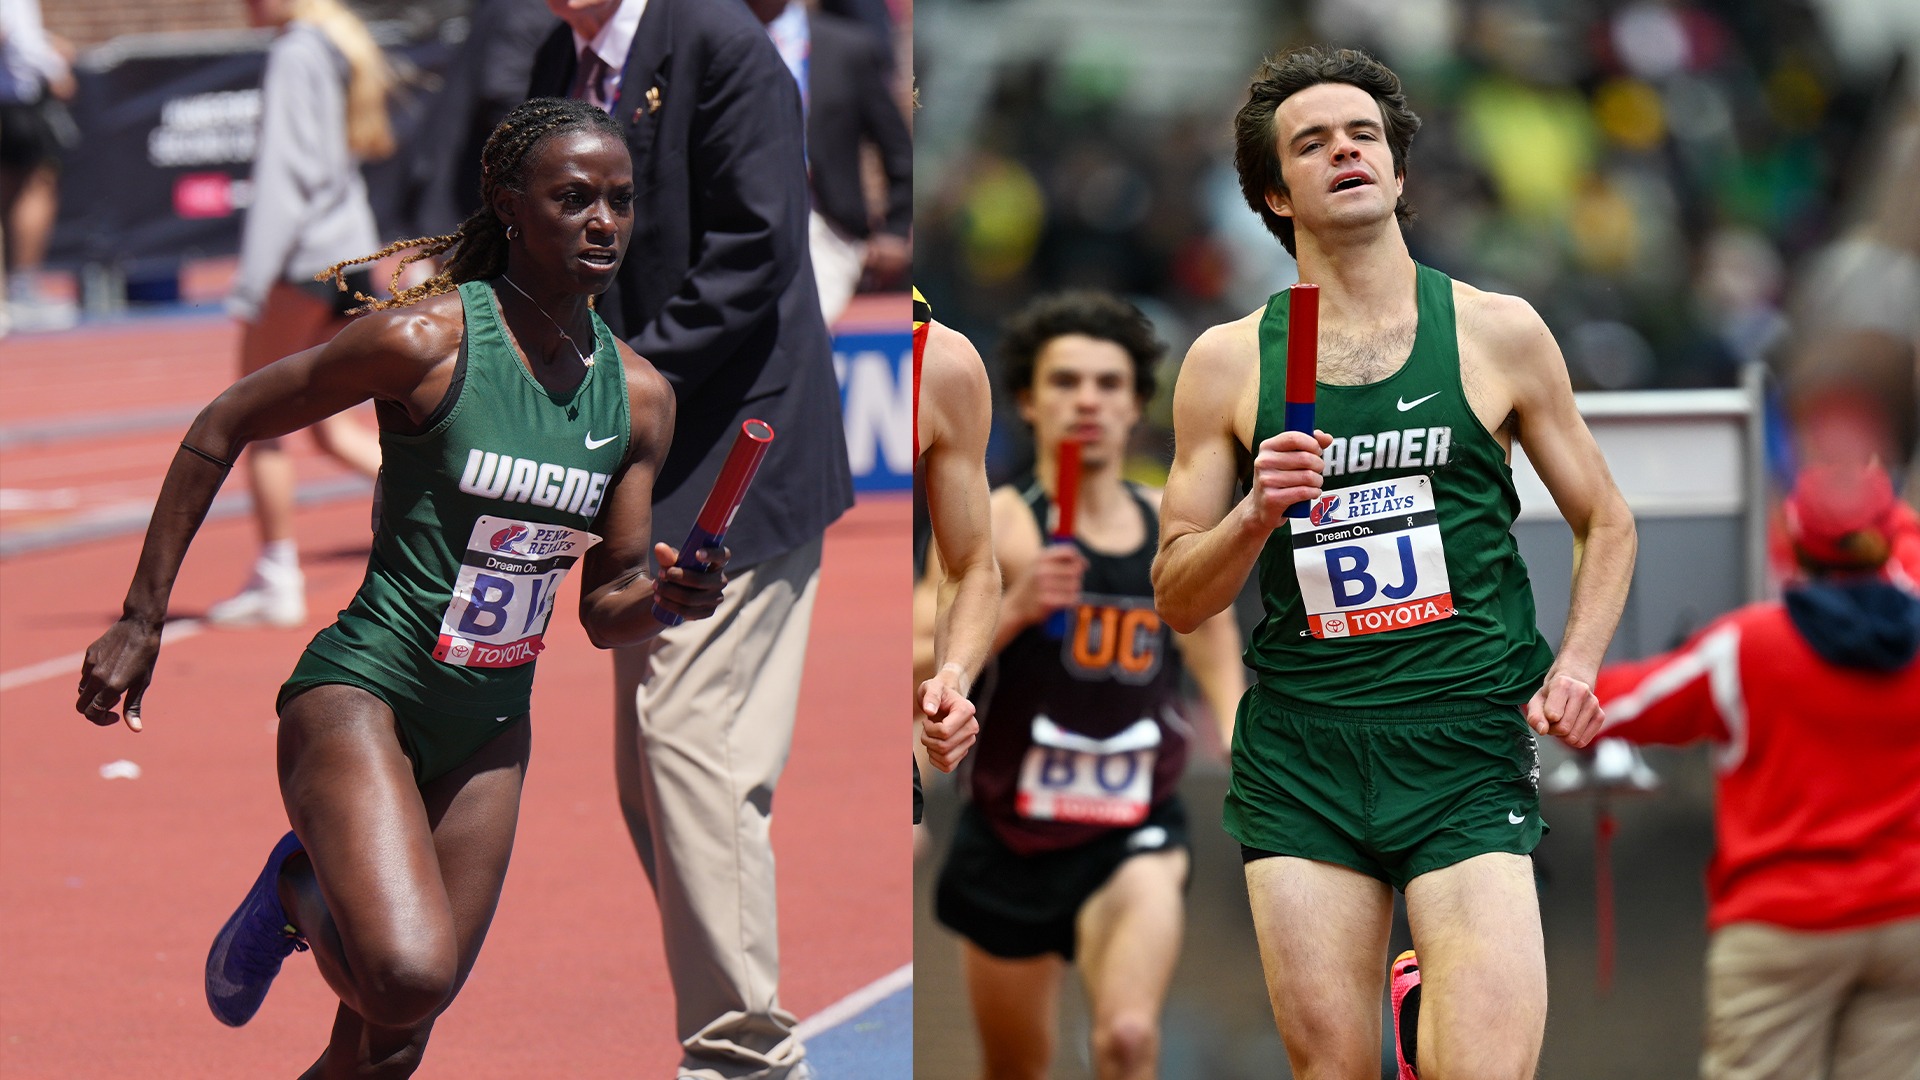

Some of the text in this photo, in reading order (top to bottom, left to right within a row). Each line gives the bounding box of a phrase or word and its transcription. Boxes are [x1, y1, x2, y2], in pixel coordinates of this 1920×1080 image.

[1322, 426, 1452, 477] AGNER
[459, 448, 613, 517] WAGNE
[1348, 484, 1397, 505] PENN
[1348, 495, 1414, 519] RELAYS
[533, 529, 574, 541] PENN
[1315, 525, 1374, 543] Dream On.
[527, 541, 576, 555] RELAYS
[486, 557, 523, 573] Dream
[1324, 534, 1418, 608] BJ
[1351, 601, 1440, 631] TOYOTA
[1072, 603, 1161, 672] UC
[475, 642, 535, 664] TOYOTA
